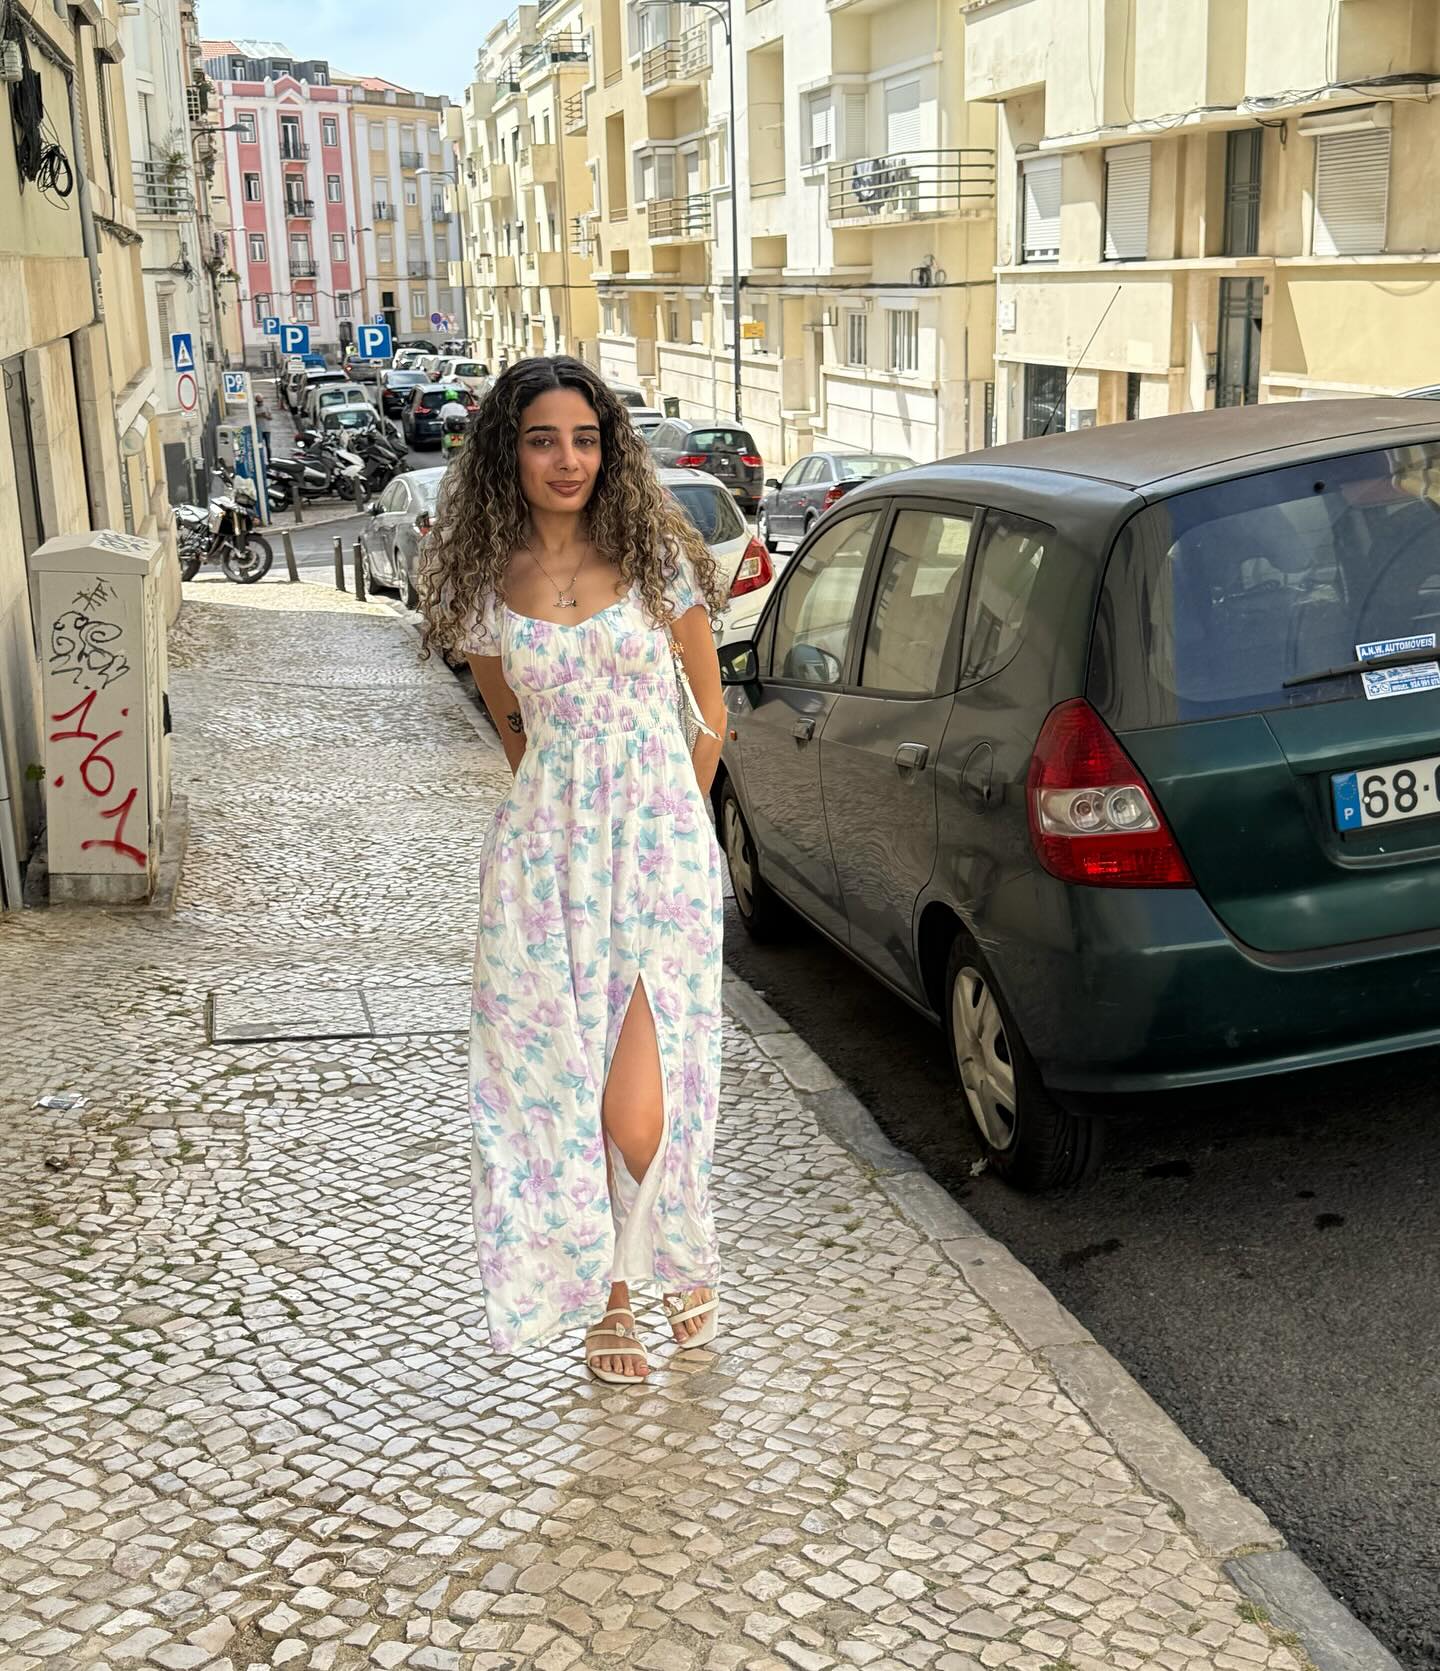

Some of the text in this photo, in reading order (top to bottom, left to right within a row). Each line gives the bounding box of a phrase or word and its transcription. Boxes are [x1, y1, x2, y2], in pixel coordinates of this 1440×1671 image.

[267, 319, 277, 334] P
[286, 327, 304, 352] P
[364, 328, 384, 356] P
[225, 375, 236, 393] P
[1344, 807, 1354, 820] P
